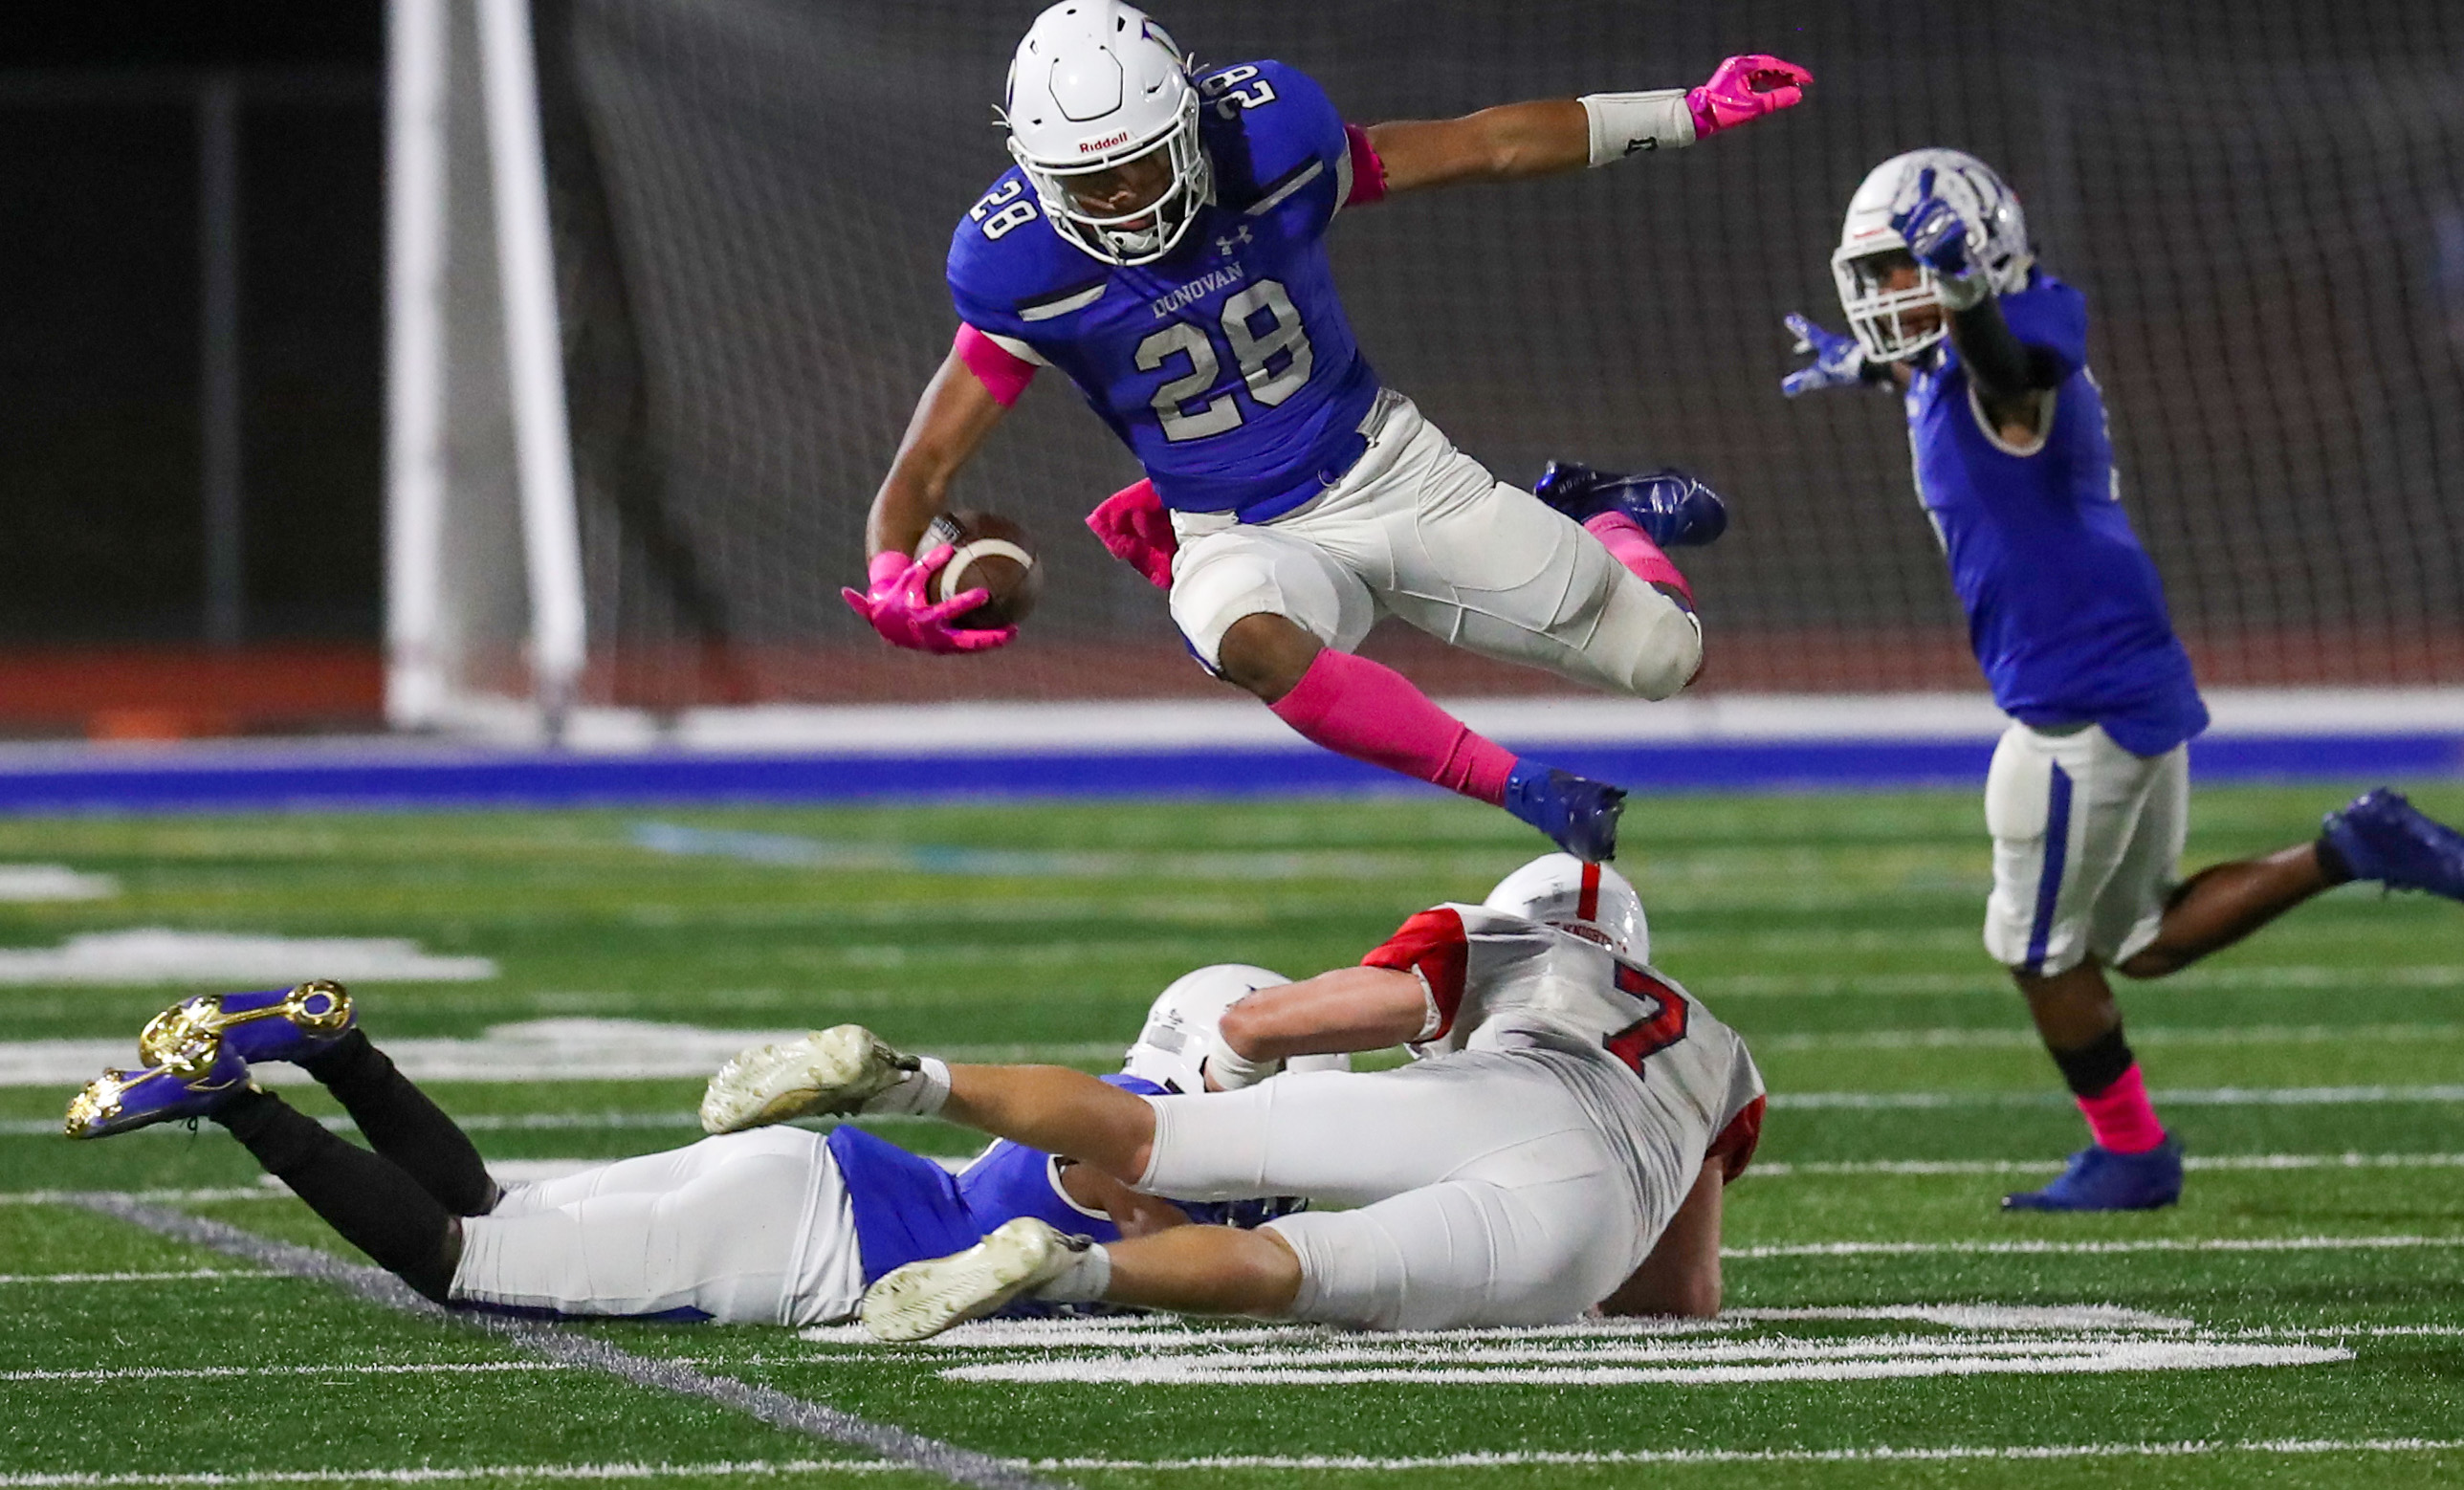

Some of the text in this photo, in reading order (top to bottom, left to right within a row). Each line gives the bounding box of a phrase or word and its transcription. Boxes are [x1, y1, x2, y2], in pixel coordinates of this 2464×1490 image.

[1079, 131, 1128, 153] Riddell
[968, 179, 1039, 241] 28
[1152, 260, 1244, 319] DONOVAN
[1133, 277, 1314, 443] 28
[1602, 956, 1689, 1082] 7
